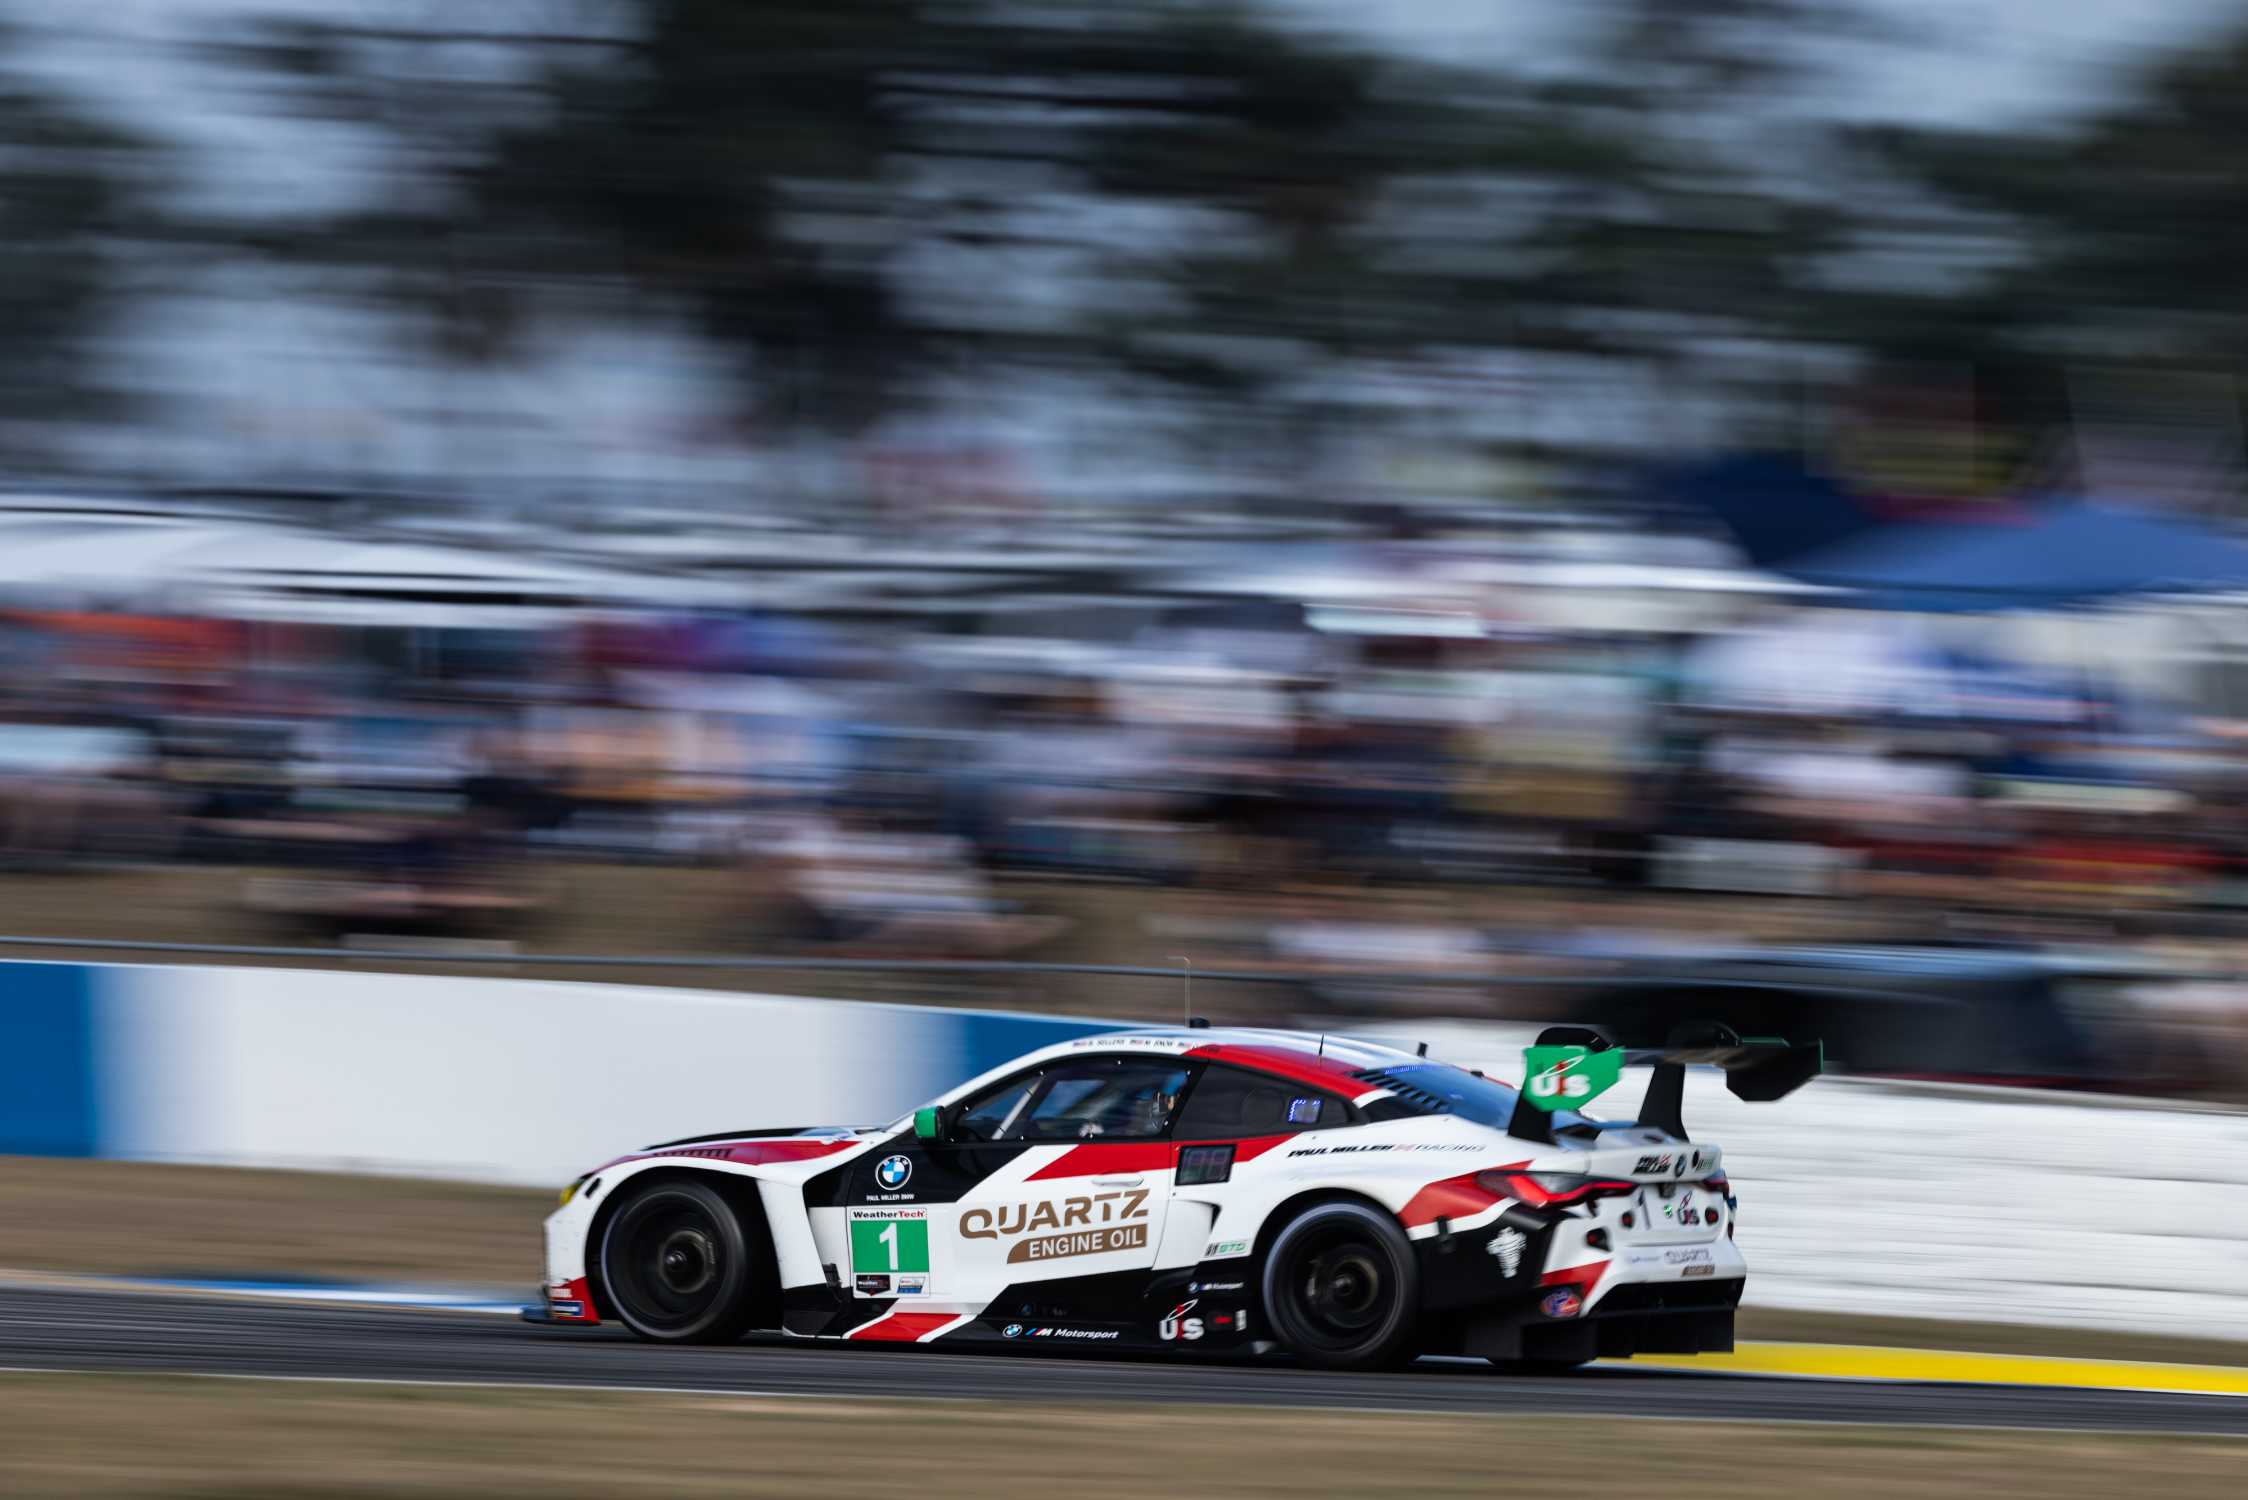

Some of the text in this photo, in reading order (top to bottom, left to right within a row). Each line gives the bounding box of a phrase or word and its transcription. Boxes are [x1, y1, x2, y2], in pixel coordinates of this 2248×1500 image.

[1287, 1147, 1328, 1158] PAUL
[1329, 1144, 1395, 1154] MILLER
[853, 1209, 925, 1219] WeatherTech
[959, 1188, 1151, 1240] QUARTZ
[879, 1221, 899, 1271] 1
[1028, 1228, 1144, 1258] ENGINE OIL
[1054, 1328, 1119, 1339] Motorsport
